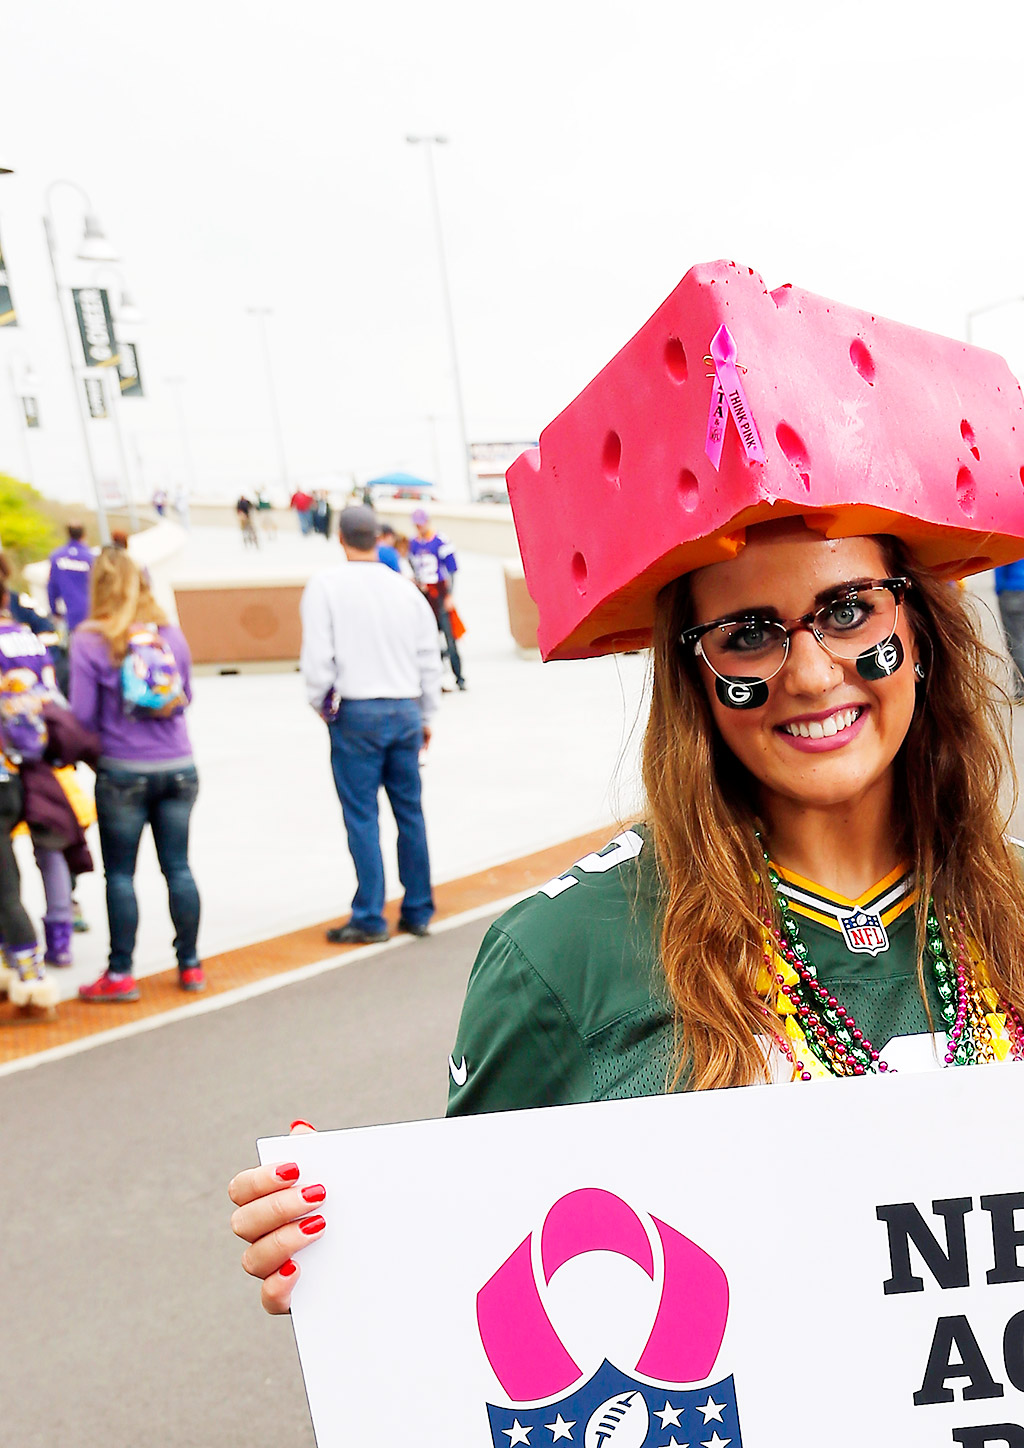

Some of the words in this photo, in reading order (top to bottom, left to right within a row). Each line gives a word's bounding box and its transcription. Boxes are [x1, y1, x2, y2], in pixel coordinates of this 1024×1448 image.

[729, 389, 748, 423] THINK
[727, 682, 751, 703] G
[850, 927, 884, 947] NFL
